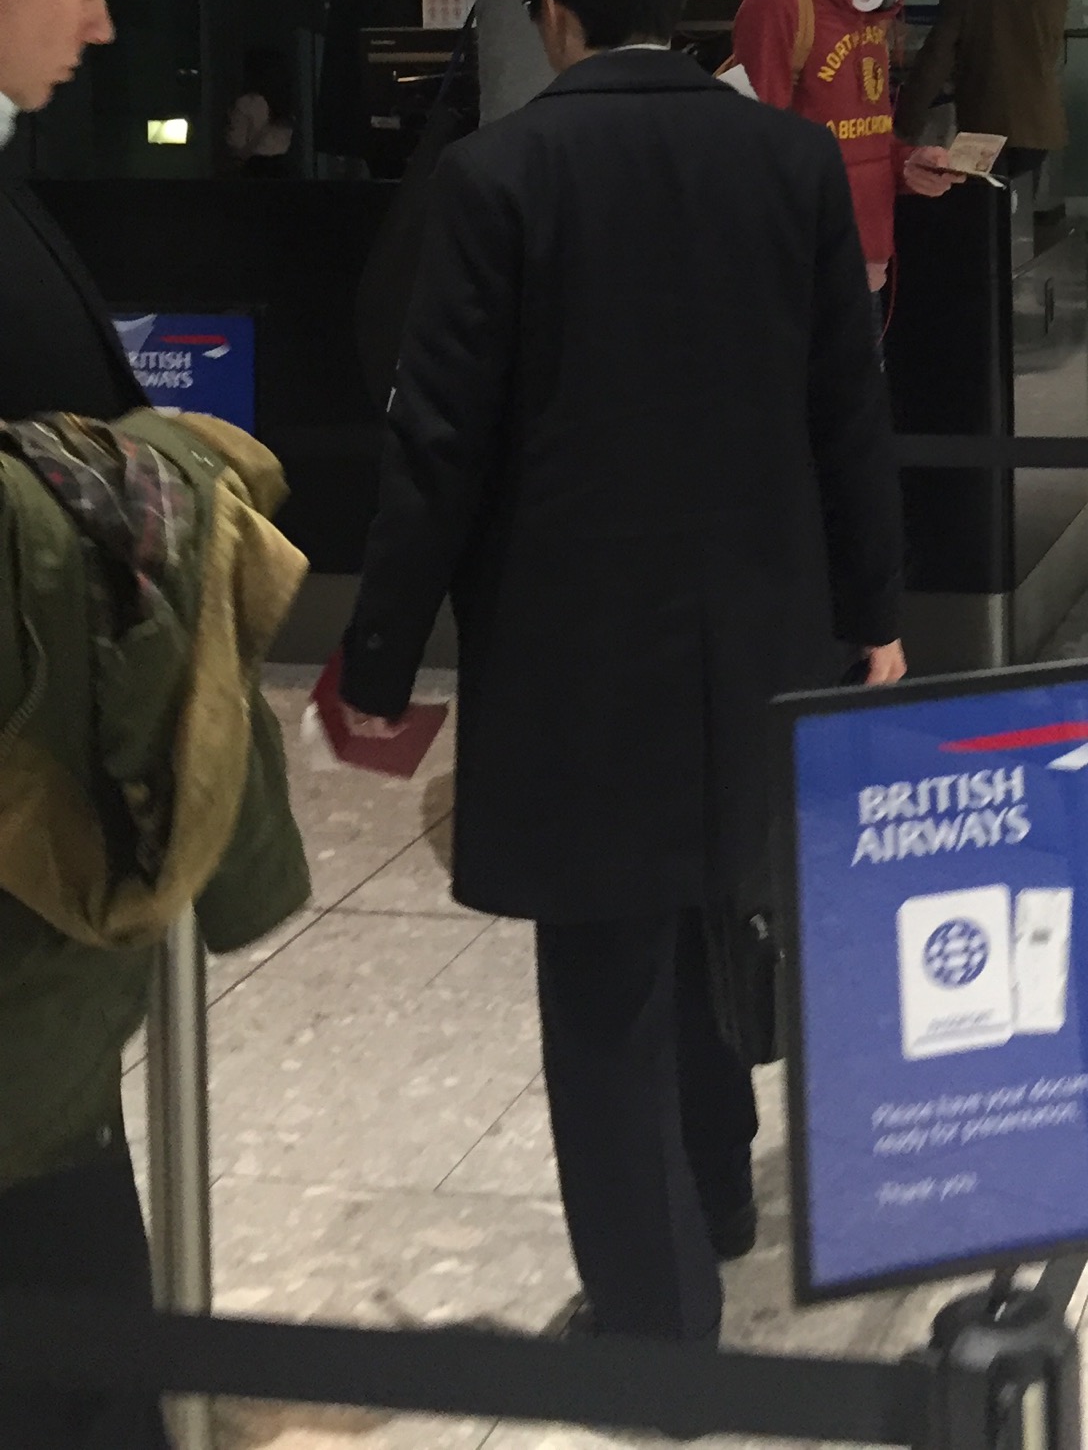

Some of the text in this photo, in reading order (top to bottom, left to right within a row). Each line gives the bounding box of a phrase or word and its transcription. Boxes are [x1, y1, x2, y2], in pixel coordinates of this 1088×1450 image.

[127, 350, 192, 370] RITISH
[857, 766, 1025, 826] BRITISH
[850, 804, 1032, 867] AIRWAYS
